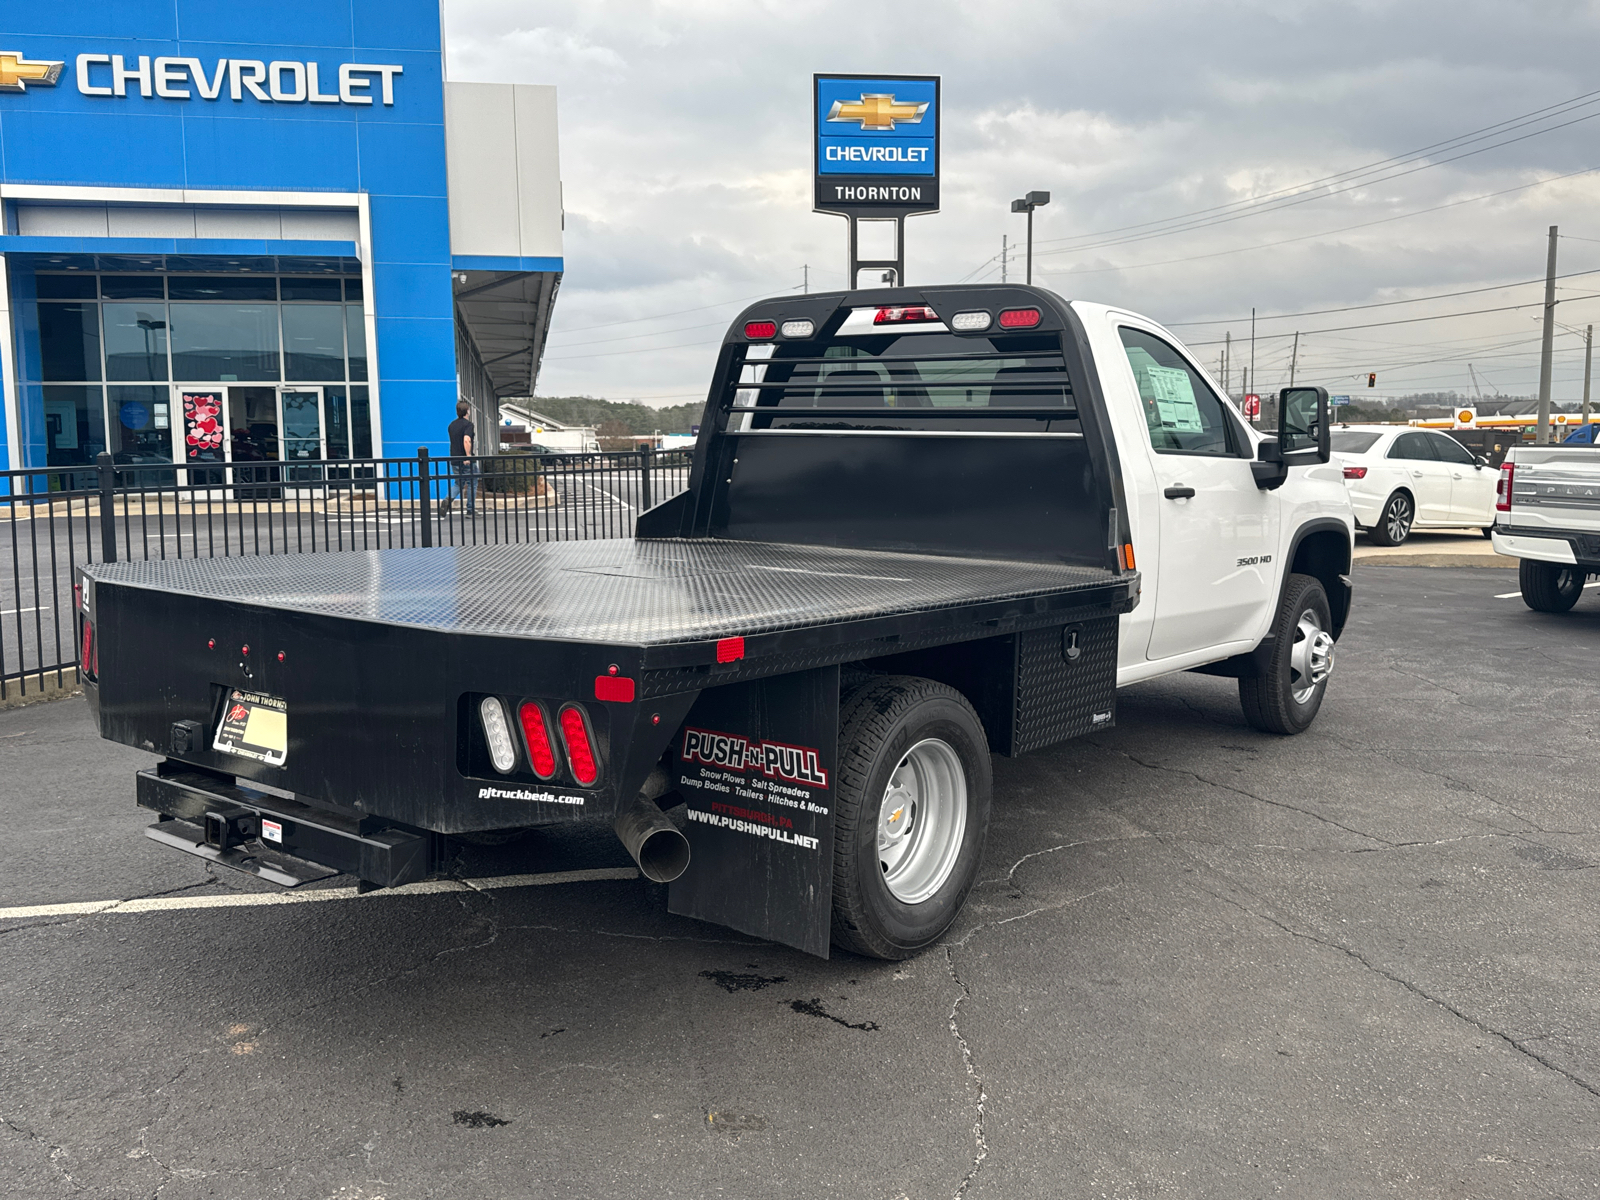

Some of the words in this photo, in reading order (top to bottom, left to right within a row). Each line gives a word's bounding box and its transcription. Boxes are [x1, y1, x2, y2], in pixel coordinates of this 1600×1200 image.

[76, 53, 403, 105] CHEVROLET
[826, 146, 929, 162] CHEVROLET
[835, 186, 921, 200] THORNTON
[1236, 556, 1259, 567] 3500
[1260, 555, 1272, 564] HD
[243, 692, 261, 704] JOHN
[680, 775, 703, 788] Dump
[704, 780, 730, 793] Bodies
[735, 787, 764, 801] Trailers
[768, 793, 798, 809] Hitches
[799, 800, 806, 810] &
[807, 801, 829, 815] More
[700, 768, 721, 780] Snow
[722, 772, 746, 785] Plows
[751, 778, 767, 790] Salt
[768, 783, 810, 799] Spreaders
[478, 787, 584, 806] pjtruckbeds.com
[711, 802, 778, 827] PITTSBURGH,
[779, 816, 793, 829] PA
[687, 808, 819, 850] WWW.PUSHNPULL.NET
